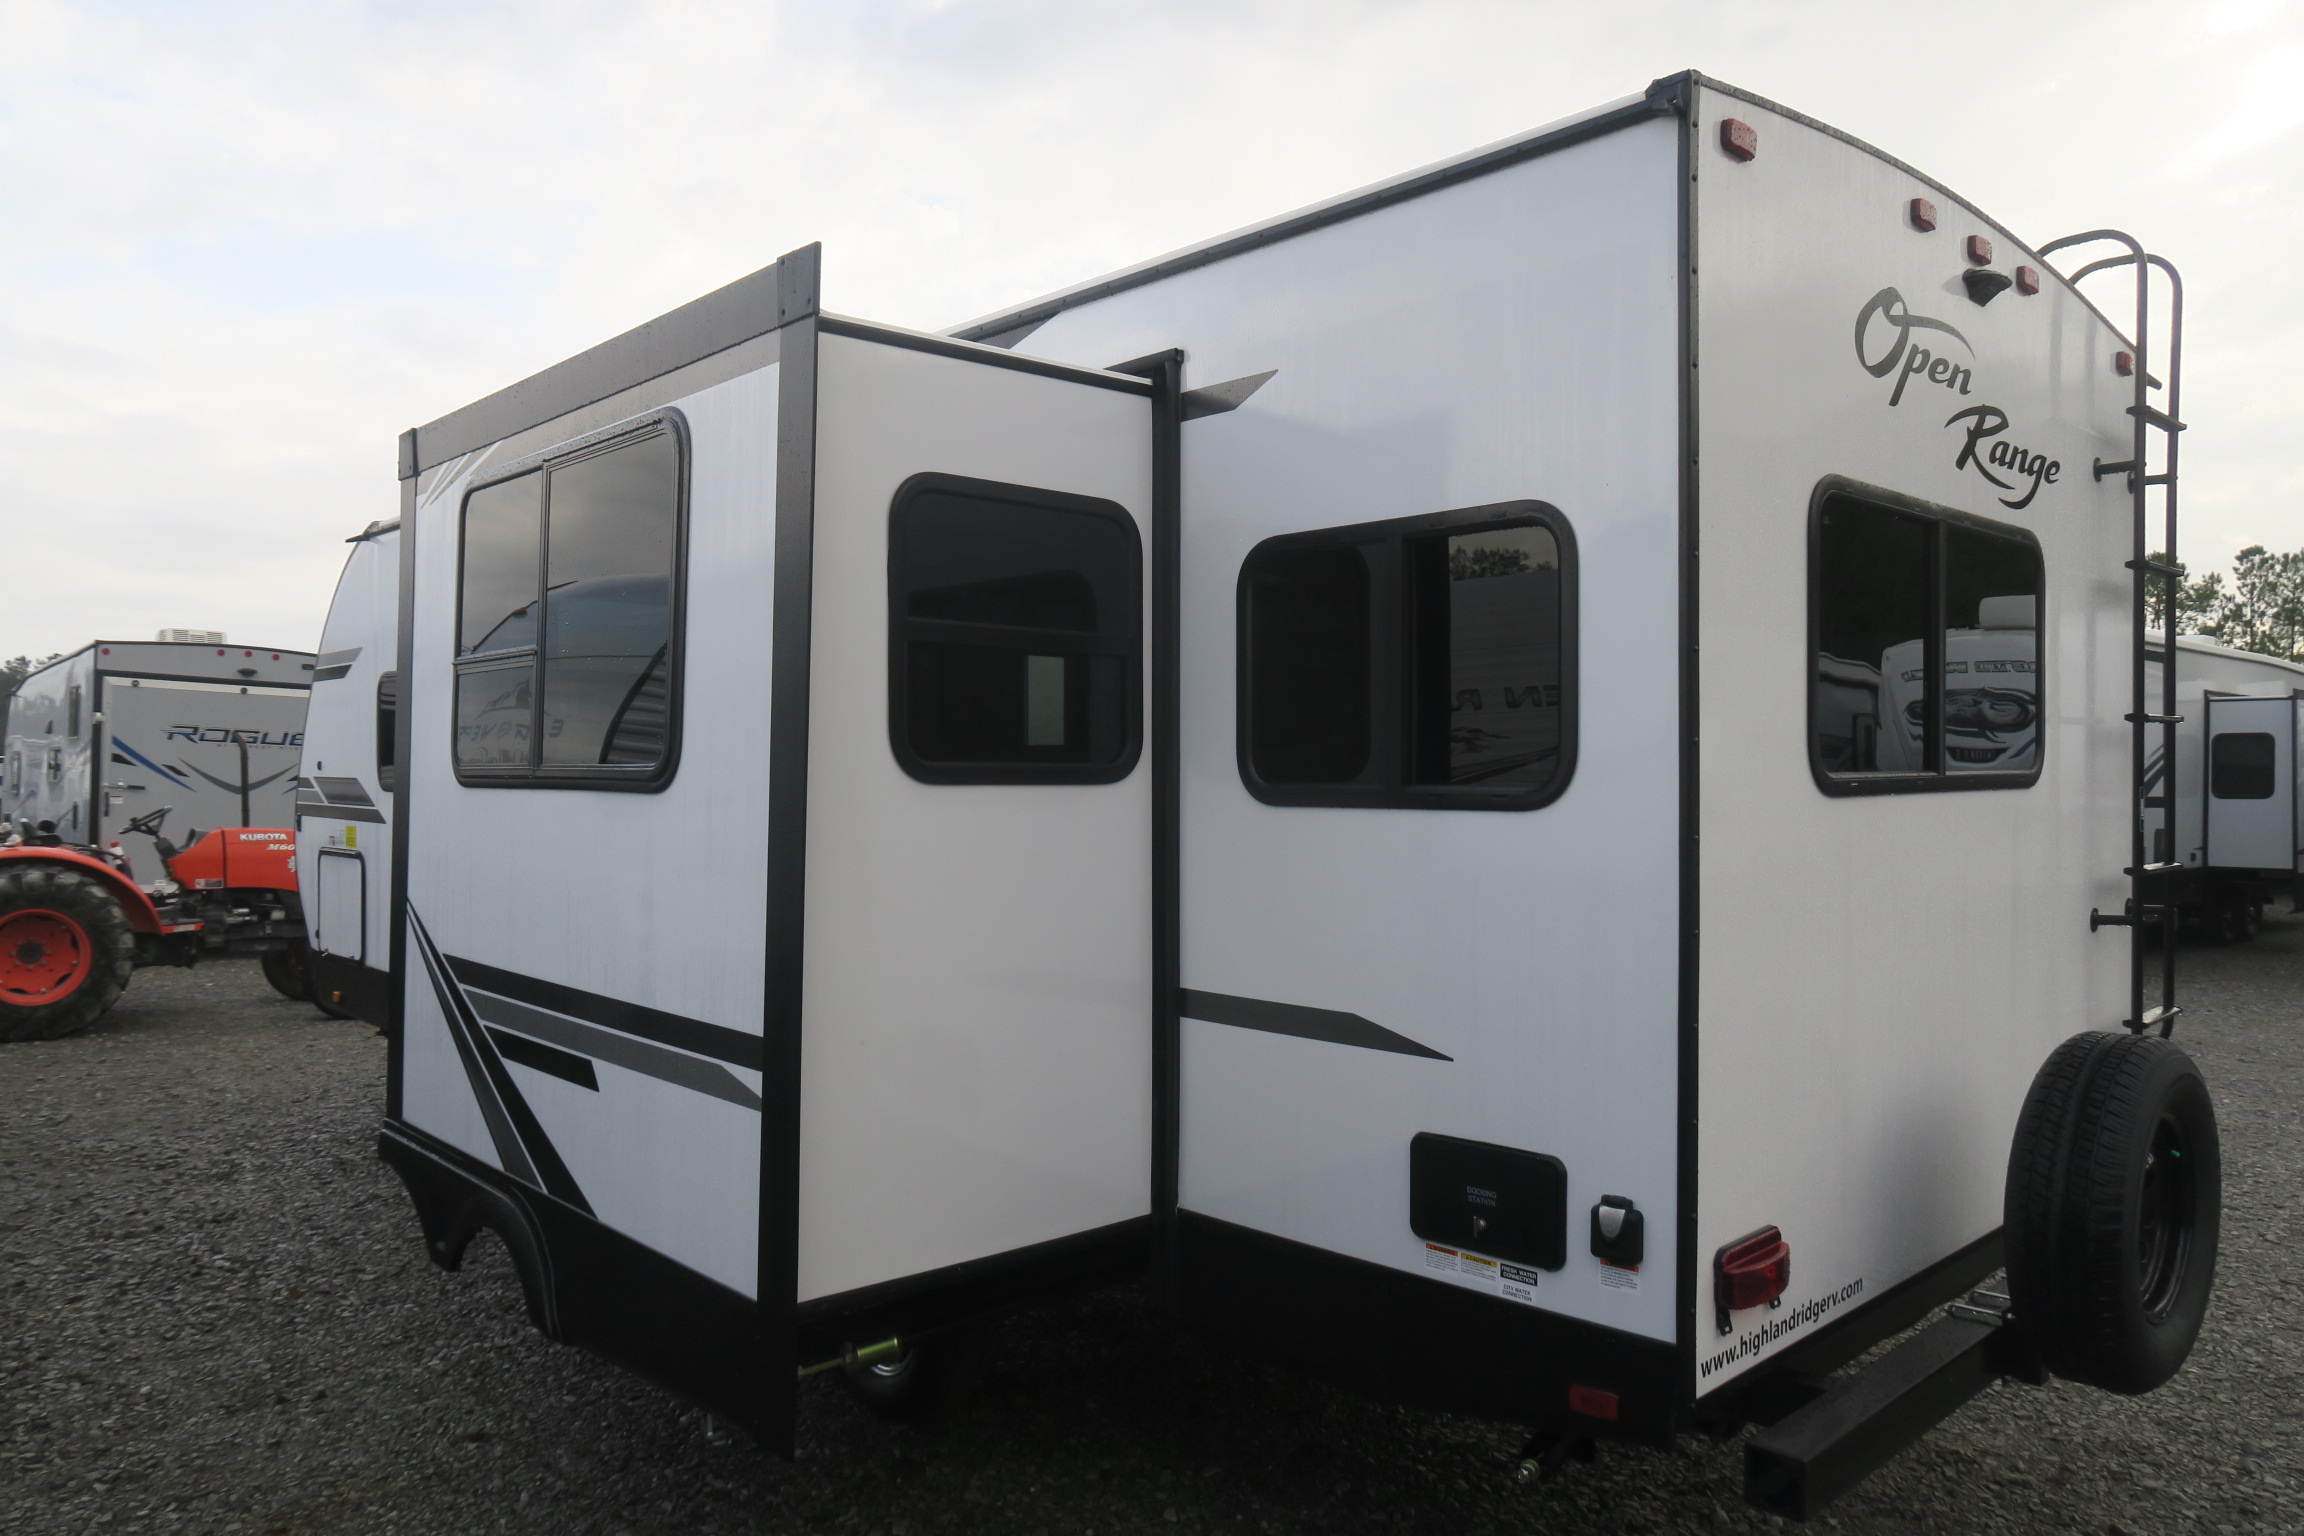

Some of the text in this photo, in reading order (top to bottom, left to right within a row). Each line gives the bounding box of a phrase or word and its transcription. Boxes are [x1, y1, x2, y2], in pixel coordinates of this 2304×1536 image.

[1854, 286, 1976, 407] Open
[1944, 403, 2061, 510] Range
[239, 833, 288, 841] KUBOTA
[1467, 1186, 1497, 1199] DOCKING
[1467, 1195, 1496, 1207] STATION
[1501, 1265, 1518, 1275] FRESH
[1519, 1270, 1537, 1280] WATER
[1502, 1272, 1535, 1285] CONNECTION
[1502, 1290, 1532, 1302] CONNECTION
[1503, 1284, 1531, 1296] CITY WATER
[1700, 1277, 1863, 1378] www.highlandridgerv.com
